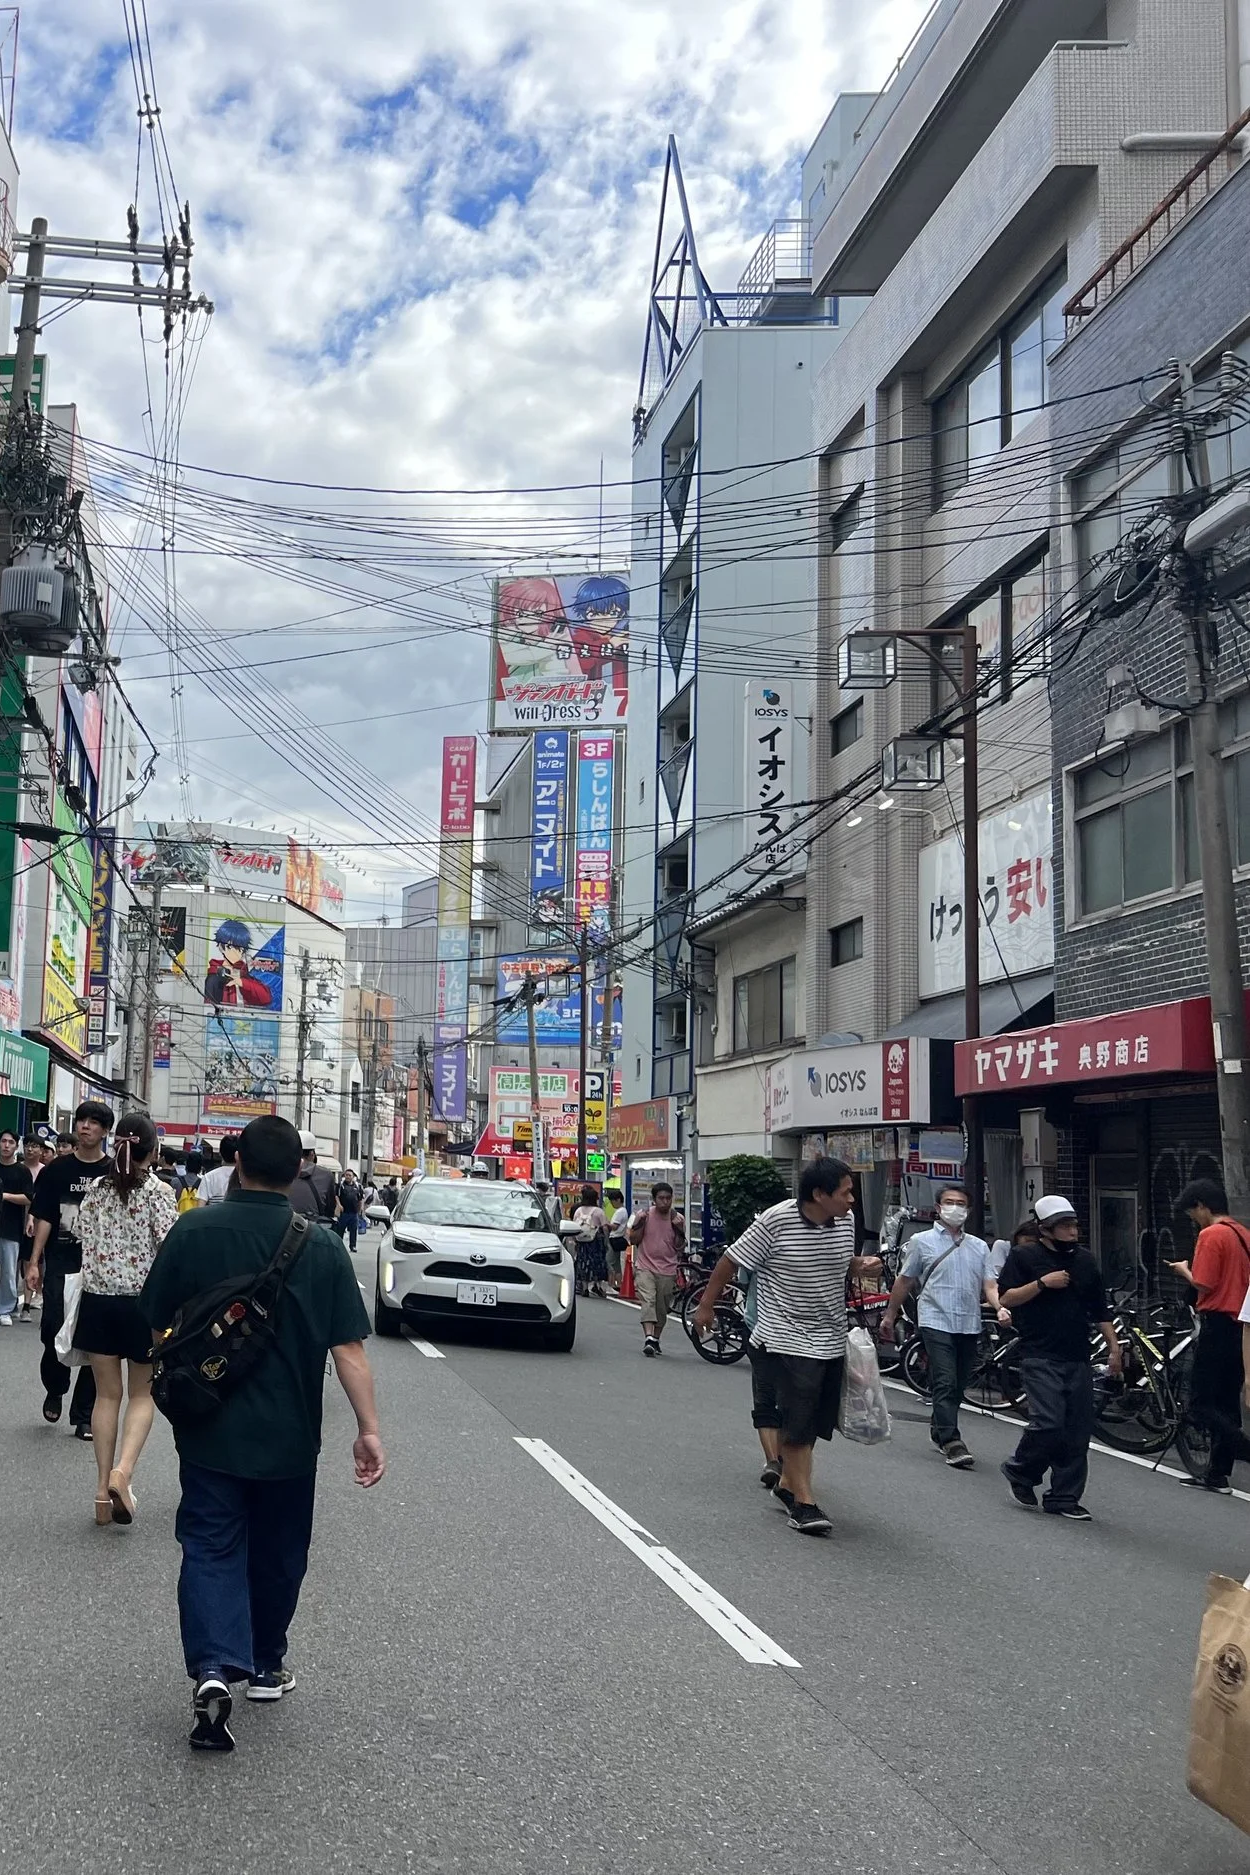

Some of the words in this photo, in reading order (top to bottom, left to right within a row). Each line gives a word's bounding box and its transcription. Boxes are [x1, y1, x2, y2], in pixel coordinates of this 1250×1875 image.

[754, 708, 789, 718] IOSYS
[536, 760, 565, 769] 1F/2F
[583, 742, 609, 757] 3F
[447, 753, 469, 821] カードラボ
[757, 726, 786, 836] イオシス
[590, 762, 608, 849] らしんばん
[930, 857, 1054, 944] けっう安い
[975, 1037, 1059, 1084] ヤマザキ
[825, 1069, 867, 1094] IOSYS
[79, 1176, 92, 1184] THE
